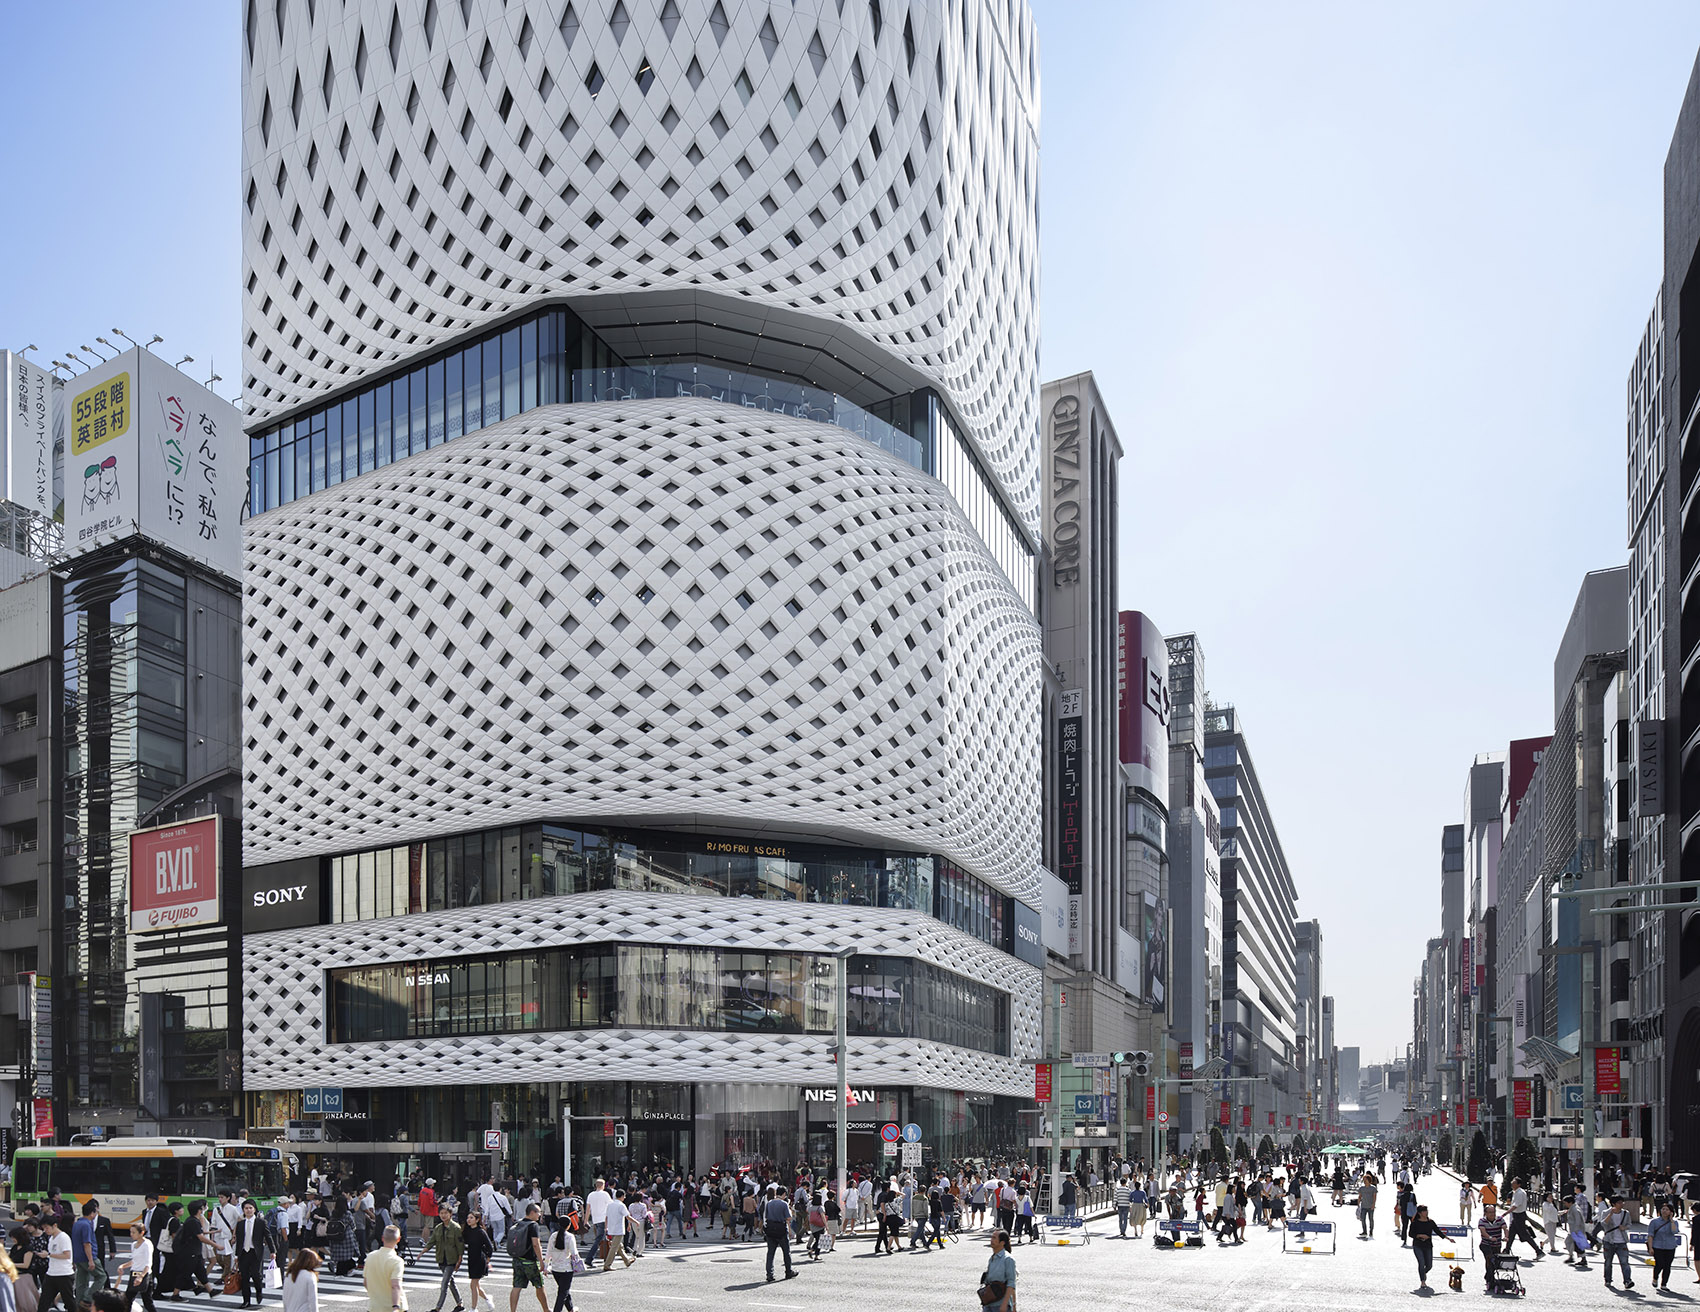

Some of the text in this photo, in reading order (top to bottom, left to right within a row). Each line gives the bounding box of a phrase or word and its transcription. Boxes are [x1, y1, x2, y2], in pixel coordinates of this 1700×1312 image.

[18, 364, 29, 428] 日本の皆様へ。
[76, 380, 125, 423] 55段階
[77, 409, 124, 448] 英語村
[198, 412, 217, 540] なんで、私が
[1053, 394, 1081, 588] GINZA CORE
[78, 516, 123, 541] 四谷学院ビル
[1061, 692, 1080, 703] 地下
[1063, 723, 1080, 796] 焼肉トラジ
[1642, 732, 1657, 806] TASAKI
[160, 831, 174, 840] Since
[1063, 800, 1079, 879] TORAJI
[733, 844, 764, 855] FRUAS
[156, 846, 198, 895] B.V.D.
[253, 885, 307, 907] SONY
[160, 906, 198, 924] FUJIBO
[1018, 924, 1039, 945] SONY
[405, 973, 451, 987] NSSAN
[805, 1089, 875, 1102] NISAN
[643, 1111, 684, 1120] GINZA PLACE
